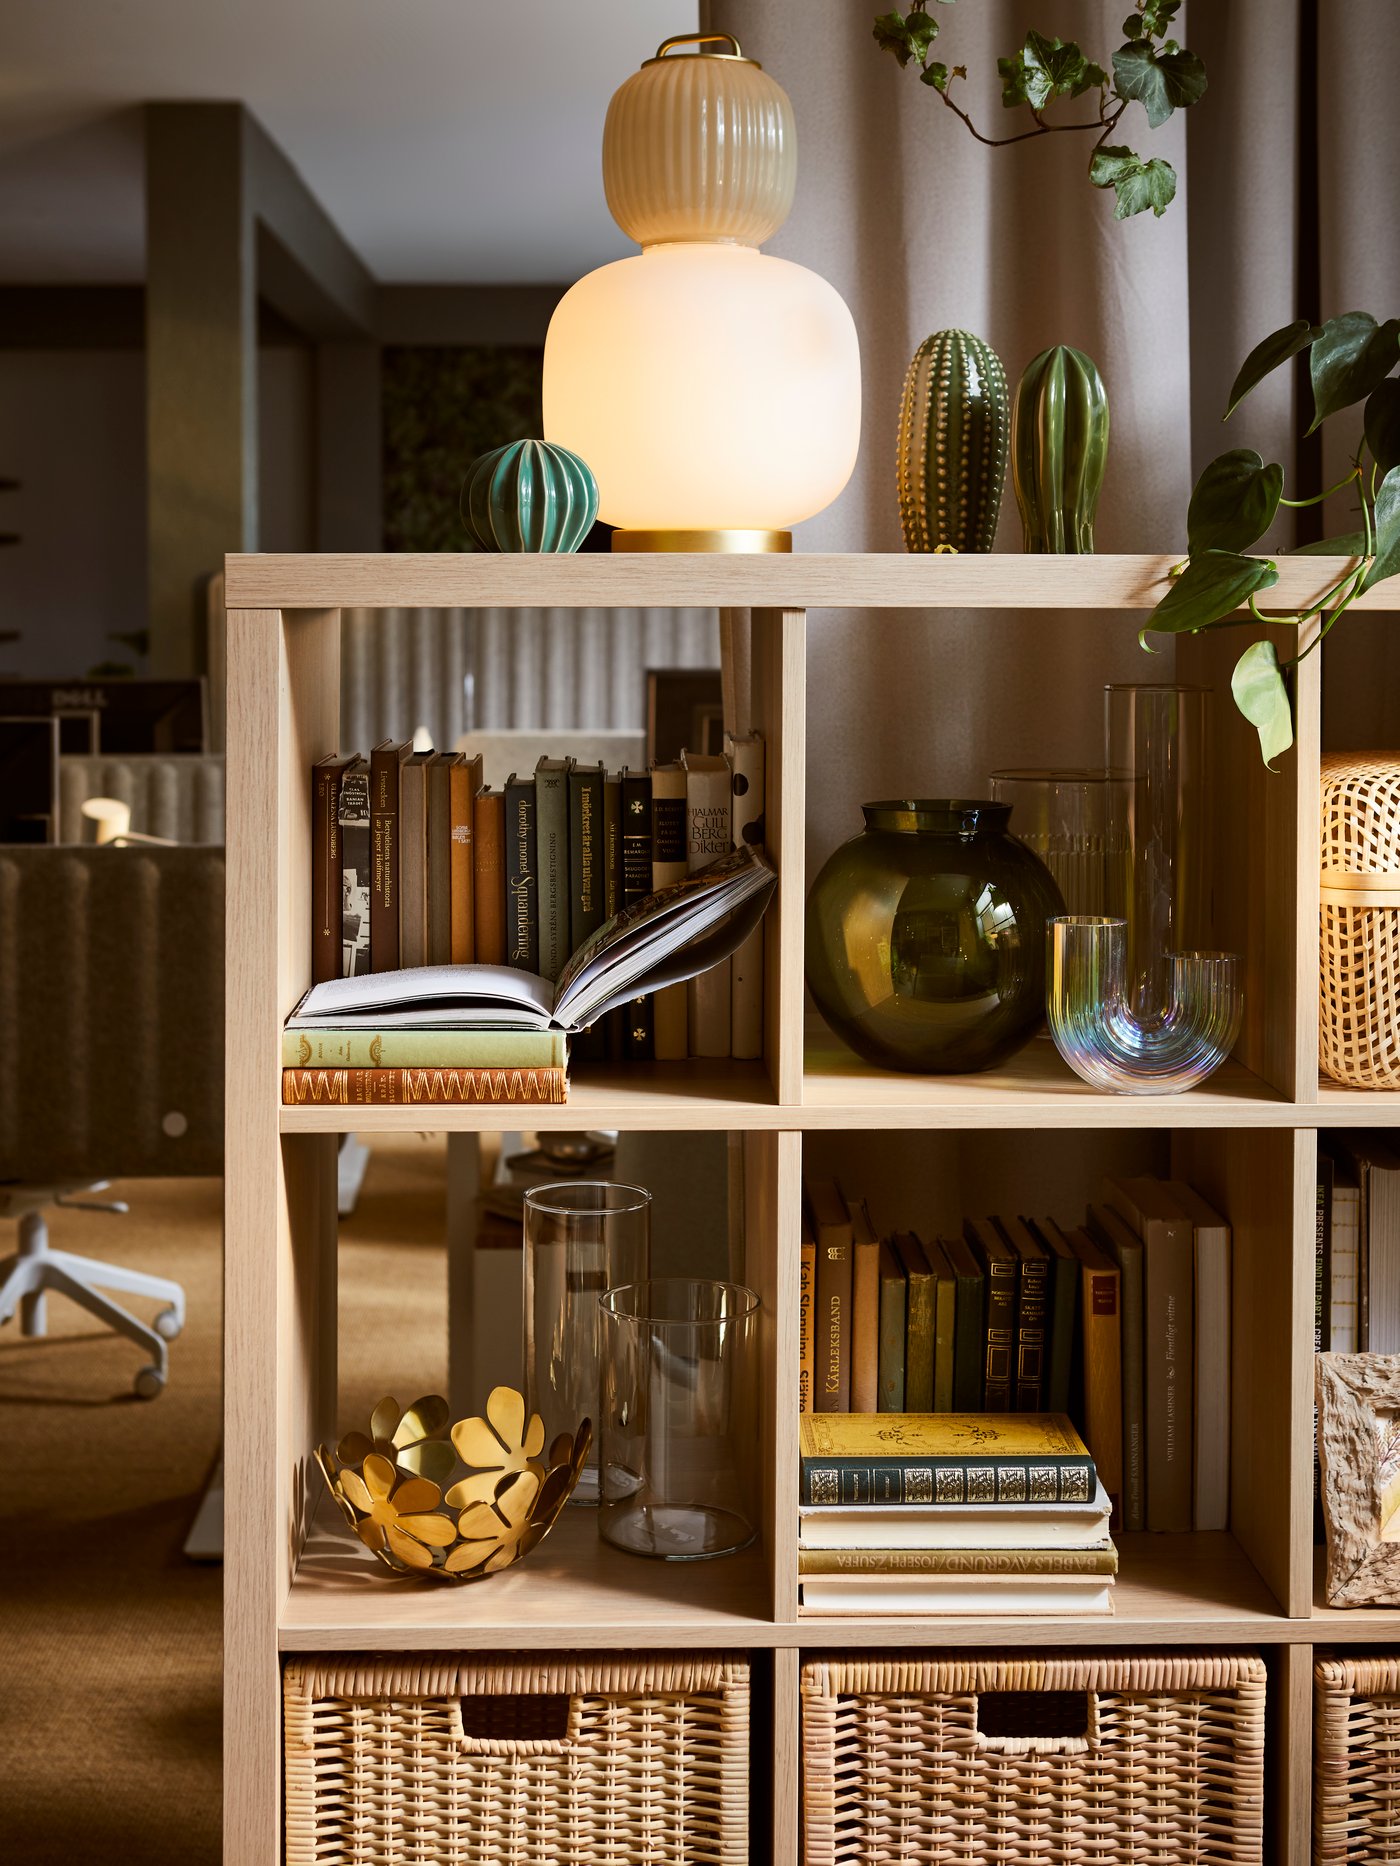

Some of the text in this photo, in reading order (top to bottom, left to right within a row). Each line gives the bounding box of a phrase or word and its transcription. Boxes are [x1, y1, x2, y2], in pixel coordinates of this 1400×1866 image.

[379, 770, 389, 808] Livstecken
[581, 793, 592, 835] mörkret
[688, 808, 728, 817] HJALMAR
[692, 816, 728, 828] GULL
[581, 835, 592, 847] är
[692, 827, 727, 840] BERG
[373, 819, 383, 892] av Jesper Hoffmeyer
[582, 847, 593, 866] alla
[689, 840, 729, 855] Dikter
[383, 819, 392, 908] Betydelsens naturhistoria
[549, 832, 557, 909] BERGSBESTIGNING
[510, 800, 535, 961] dorothy monet Squandering
[582, 867, 593, 894] ulvar
[580, 895, 594, 913] grå
[549, 910, 557, 942] SYRÉNS
[1316, 1209, 1324, 1255] PRESENTS
[1315, 1258, 1323, 1278] FIND
[825, 1295, 841, 1393] KÄRLEKSBAND
[1165, 1295, 1178, 1462] WILLIAM LASHNER Fientligt vittne
[836, 1555, 888, 1570] ZSUFFA
[889, 1555, 936, 1568] JOSEPH
[1034, 1556, 1097, 1571] BABELS
